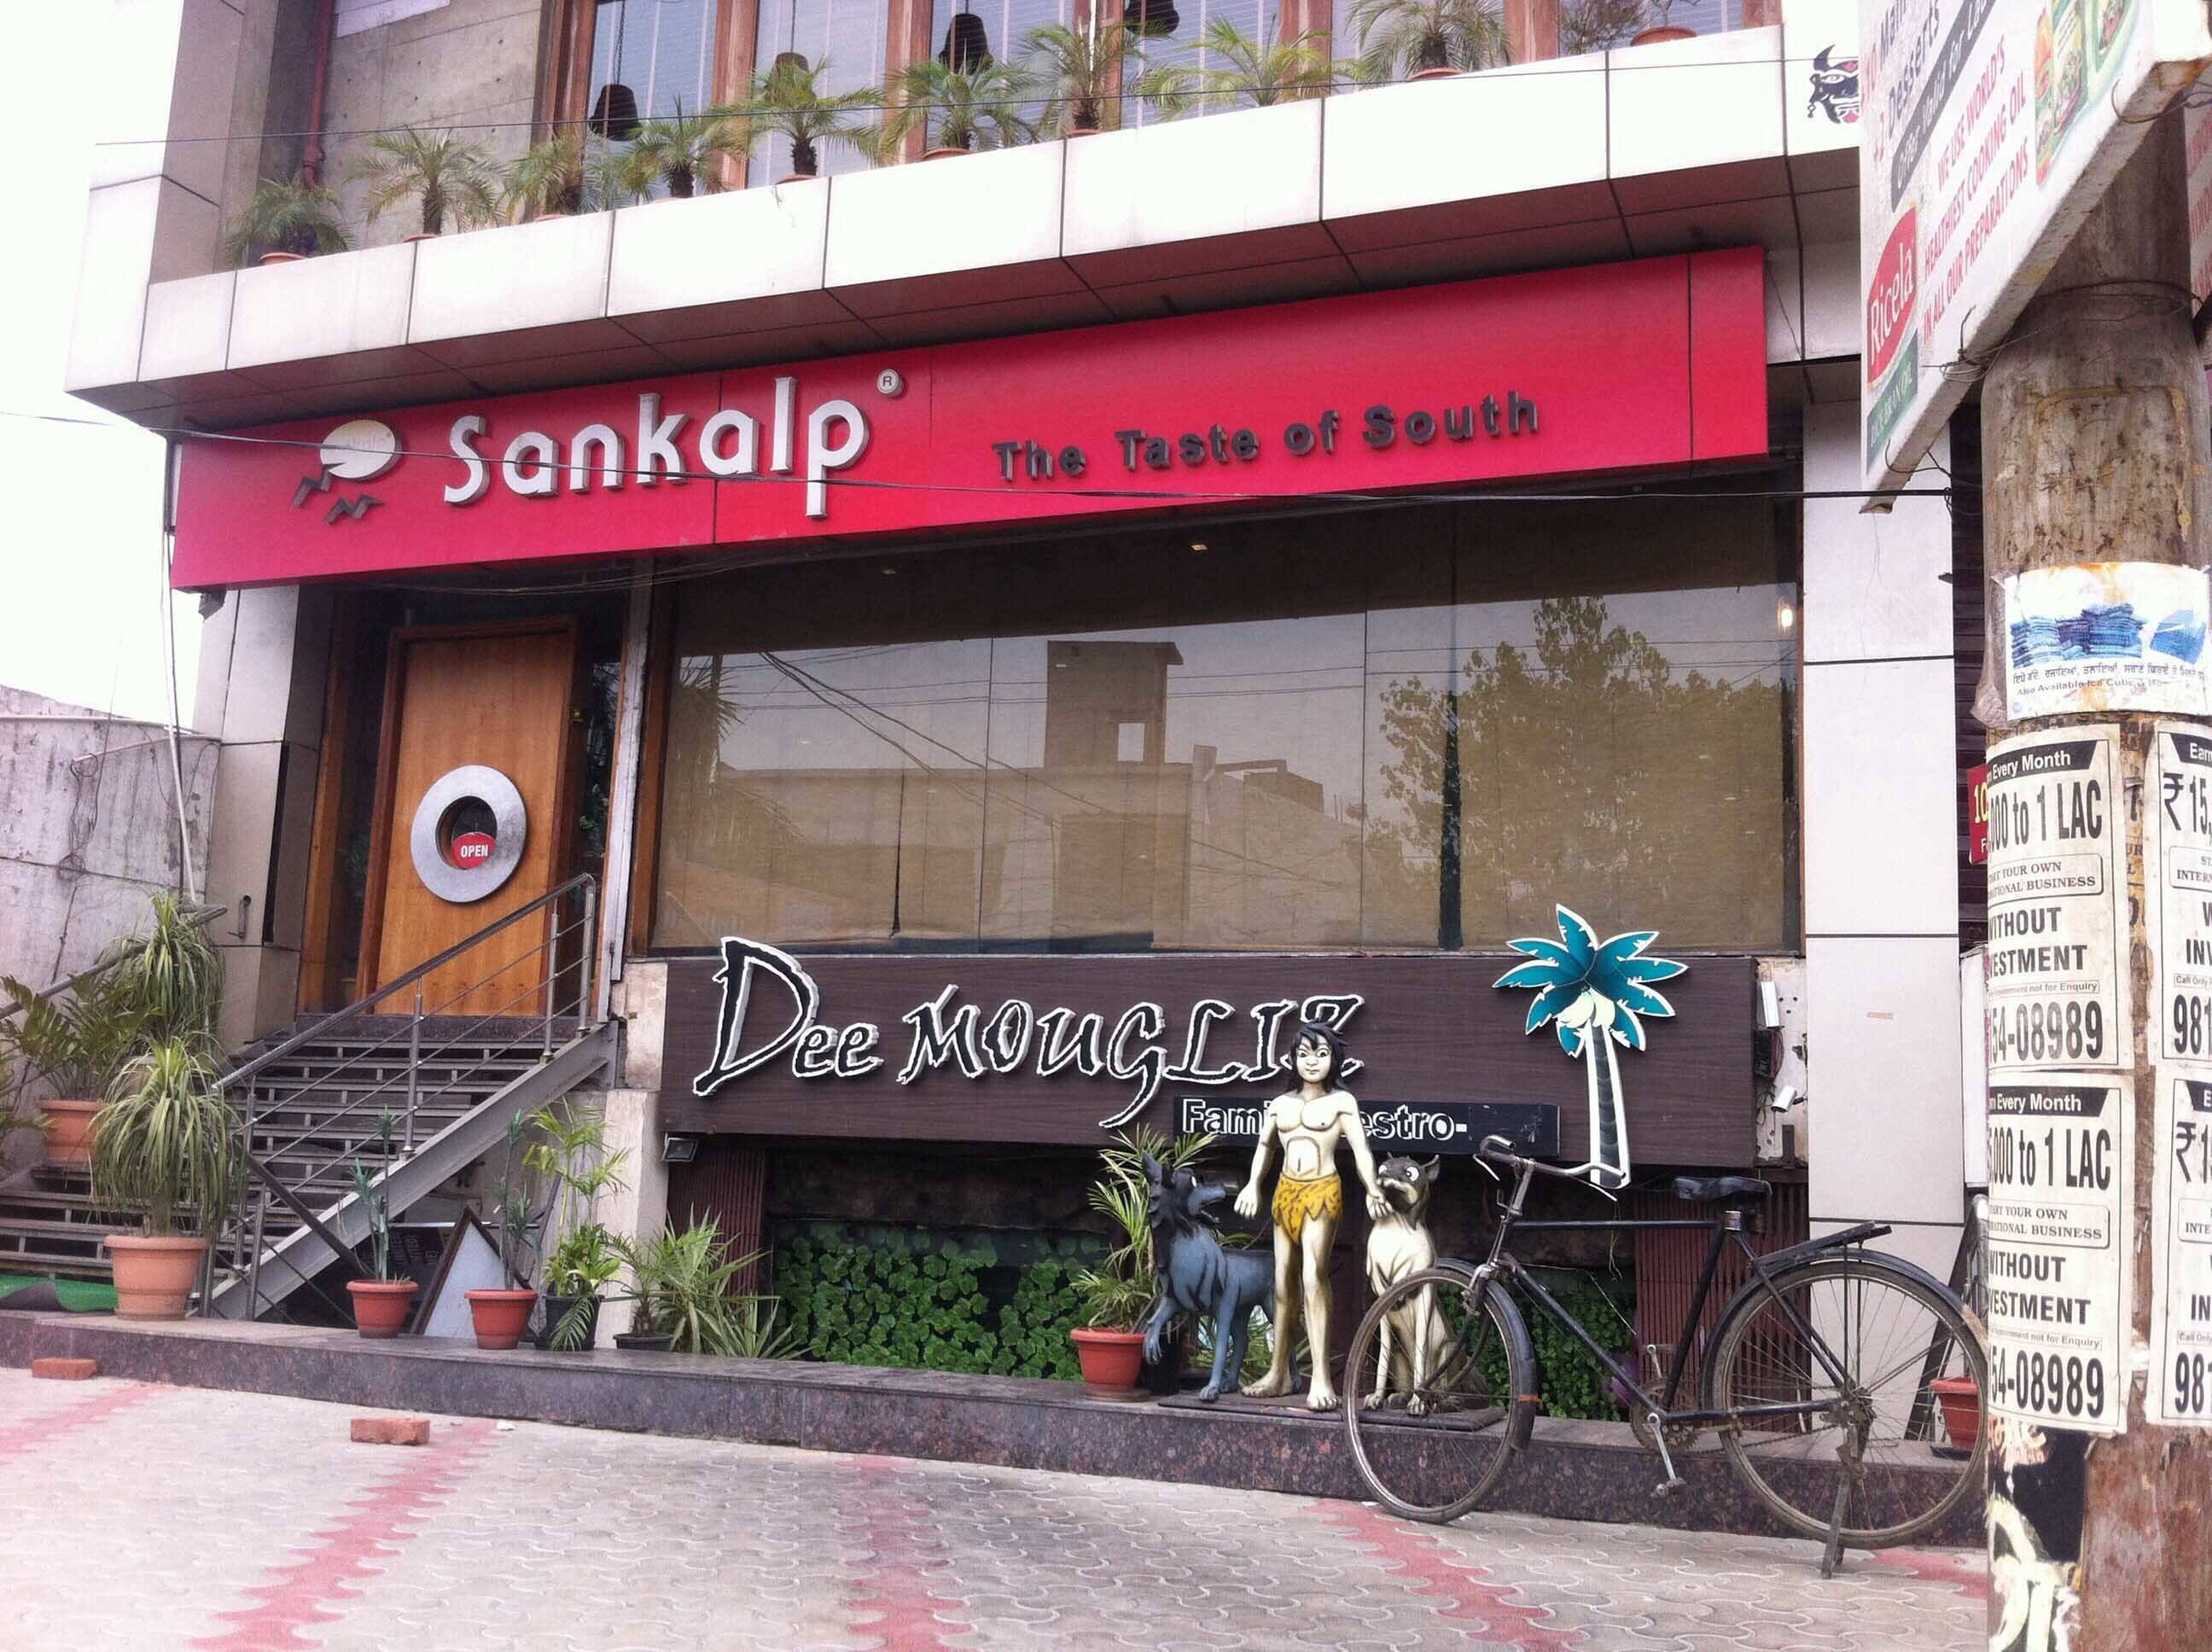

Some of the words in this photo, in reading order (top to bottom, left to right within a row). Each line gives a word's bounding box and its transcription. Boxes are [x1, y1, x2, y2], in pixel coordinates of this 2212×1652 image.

[1952, 113, 1965, 167] USE
[1967, 34, 2005, 137] WORLD'S
[1925, 178, 1965, 282] HEALTHIEST
[1968, 104, 2006, 201] COOKING
[2010, 69, 2025, 126] OIL
[1924, 304, 1932, 345] IN
[1933, 282, 1945, 329] ALL
[1947, 249, 1964, 304] OUR
[1965, 136, 2029, 276] PREPARATIONS
[1871, 241, 1913, 366] Ricela
[444, 375, 869, 518] Sankalp
[993, 440, 1086, 481] The
[1115, 423, 1260, 471] Taste
[1284, 410, 1339, 454] of
[1363, 391, 1539, 449] South
[2038, 679, 2083, 691] Available
[1993, 760, 2018, 779] Every
[2022, 750, 2070, 771] Month
[2013, 792, 2029, 845] to
[2037, 784, 2046, 841] 1
[2058, 779, 2102, 840] LAC
[460, 844, 489, 858] OPEN
[2002, 865, 2028, 879] YOUR
[2031, 862, 2062, 874] OWN
[2027, 876, 2096, 891] BUSINESS
[2029, 984, 2042, 992] not
[2045, 983, 2058, 992] for
[2060, 981, 2097, 992] Enquiry
[693, 936, 885, 1097] Dee
[1997, 1093, 2025, 1114] Every
[2030, 1093, 2081, 1112] Month
[2019, 1130, 2035, 1186] to
[2045, 1127, 2053, 1186] 1
[2066, 1128, 2111, 1190] LAC
[2005, 1206, 2032, 1218] YOUR
[2036, 1207, 2068, 1220] OWN
[2032, 1224, 2102, 1240] BUSINESS
[2031, 1332, 2044, 1342] not
[2046, 1333, 2059, 1344] for
[2061, 1335, 2099, 1348] Enquiry
